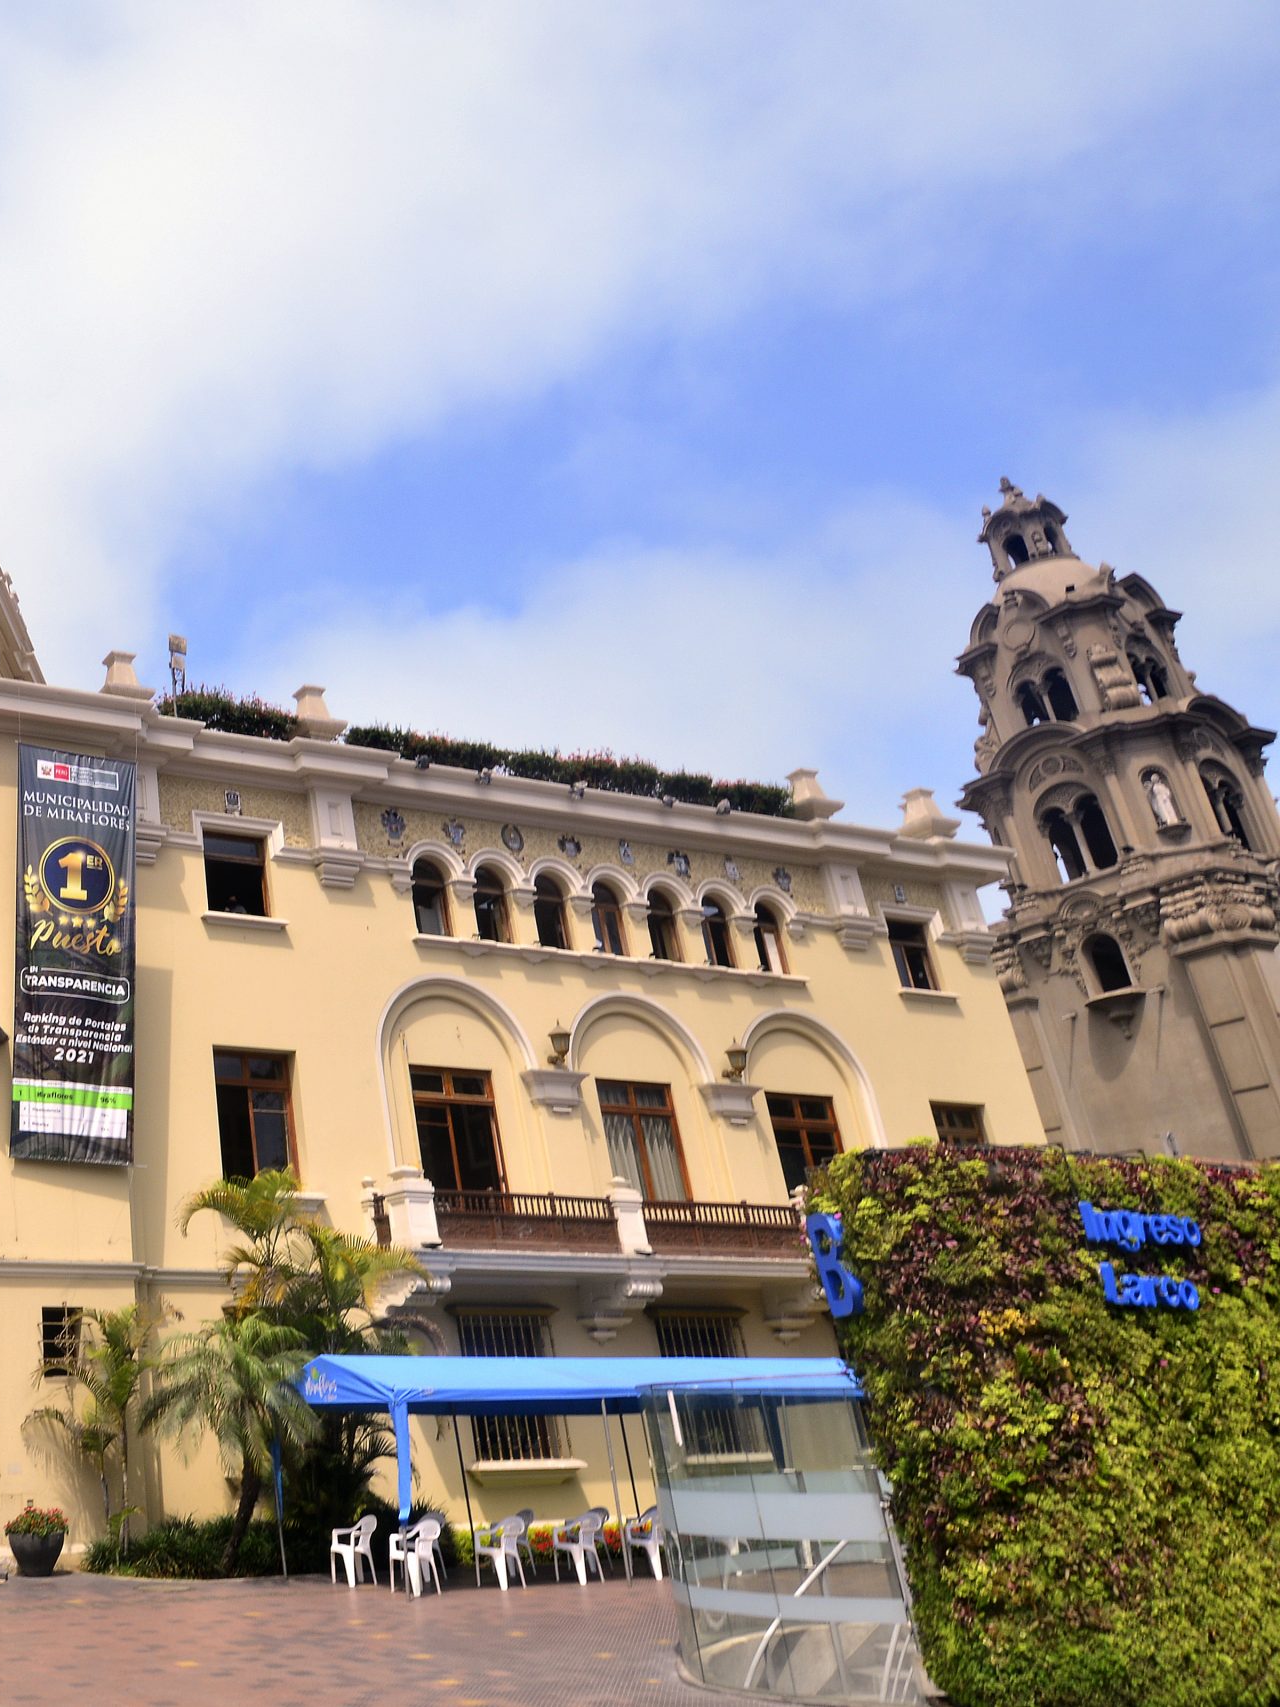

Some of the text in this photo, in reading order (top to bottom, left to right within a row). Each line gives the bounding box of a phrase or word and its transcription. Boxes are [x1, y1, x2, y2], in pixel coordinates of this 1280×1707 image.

[23, 790, 130, 817] MUNICIPALIDAD
[24, 804, 130, 832] DE MIRAFLORES
[30, 919, 122, 956] Puesto
[25, 975, 126, 996] TRANSPARENCIA
[23, 1012, 127, 1031] Ranking de Portales
[28, 1024, 122, 1042] de Transparencia
[15, 1033, 133, 1054] Estándar a nivel Nacional
[53, 1047, 95, 1064] 2021
[1078, 1200, 1201, 1252] Ingreso
[806, 1212, 864, 1317] B
[1099, 1261, 1199, 1311] Larco
